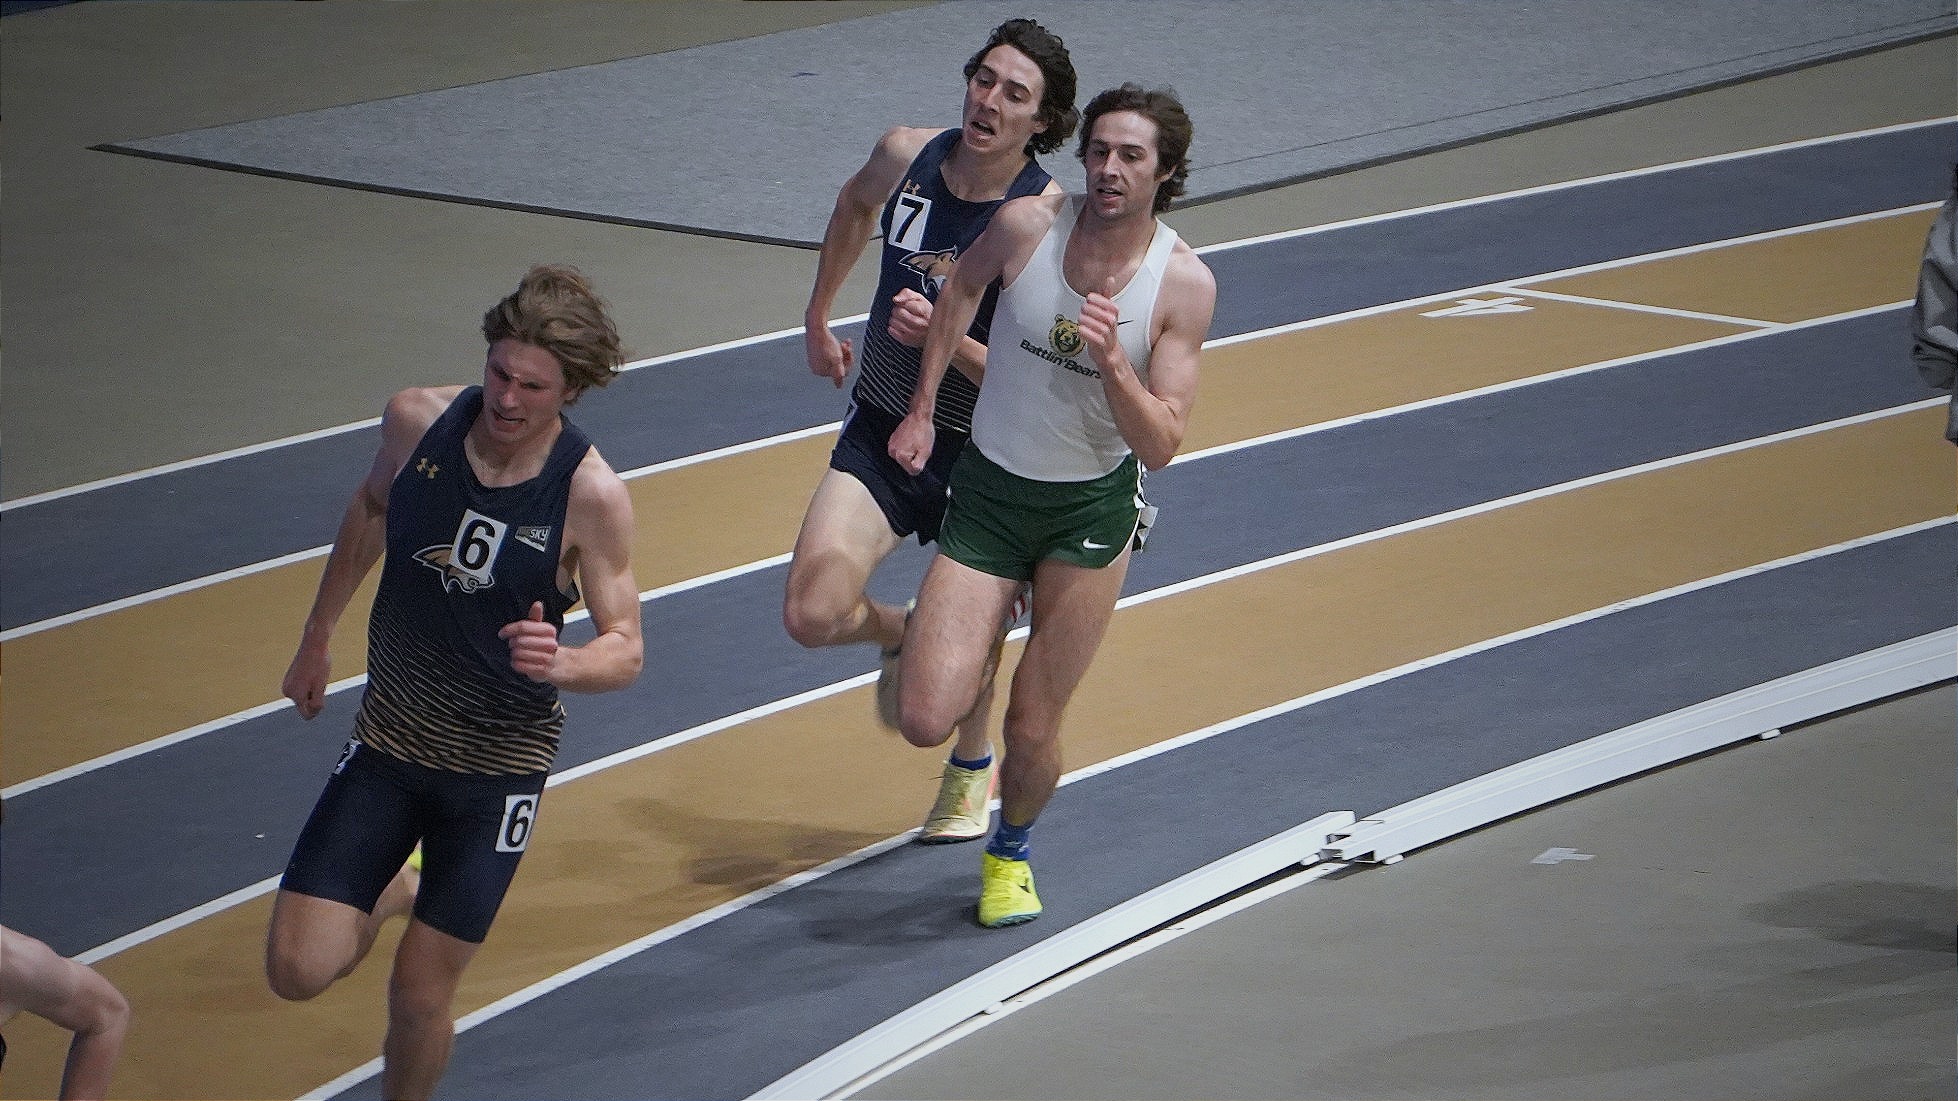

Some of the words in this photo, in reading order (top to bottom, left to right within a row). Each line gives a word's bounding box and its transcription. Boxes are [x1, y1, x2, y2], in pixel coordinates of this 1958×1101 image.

[894, 196, 925, 244] 7
[457, 518, 496, 571] 6
[530, 528, 550, 541] SKY
[504, 799, 533, 848] 6
